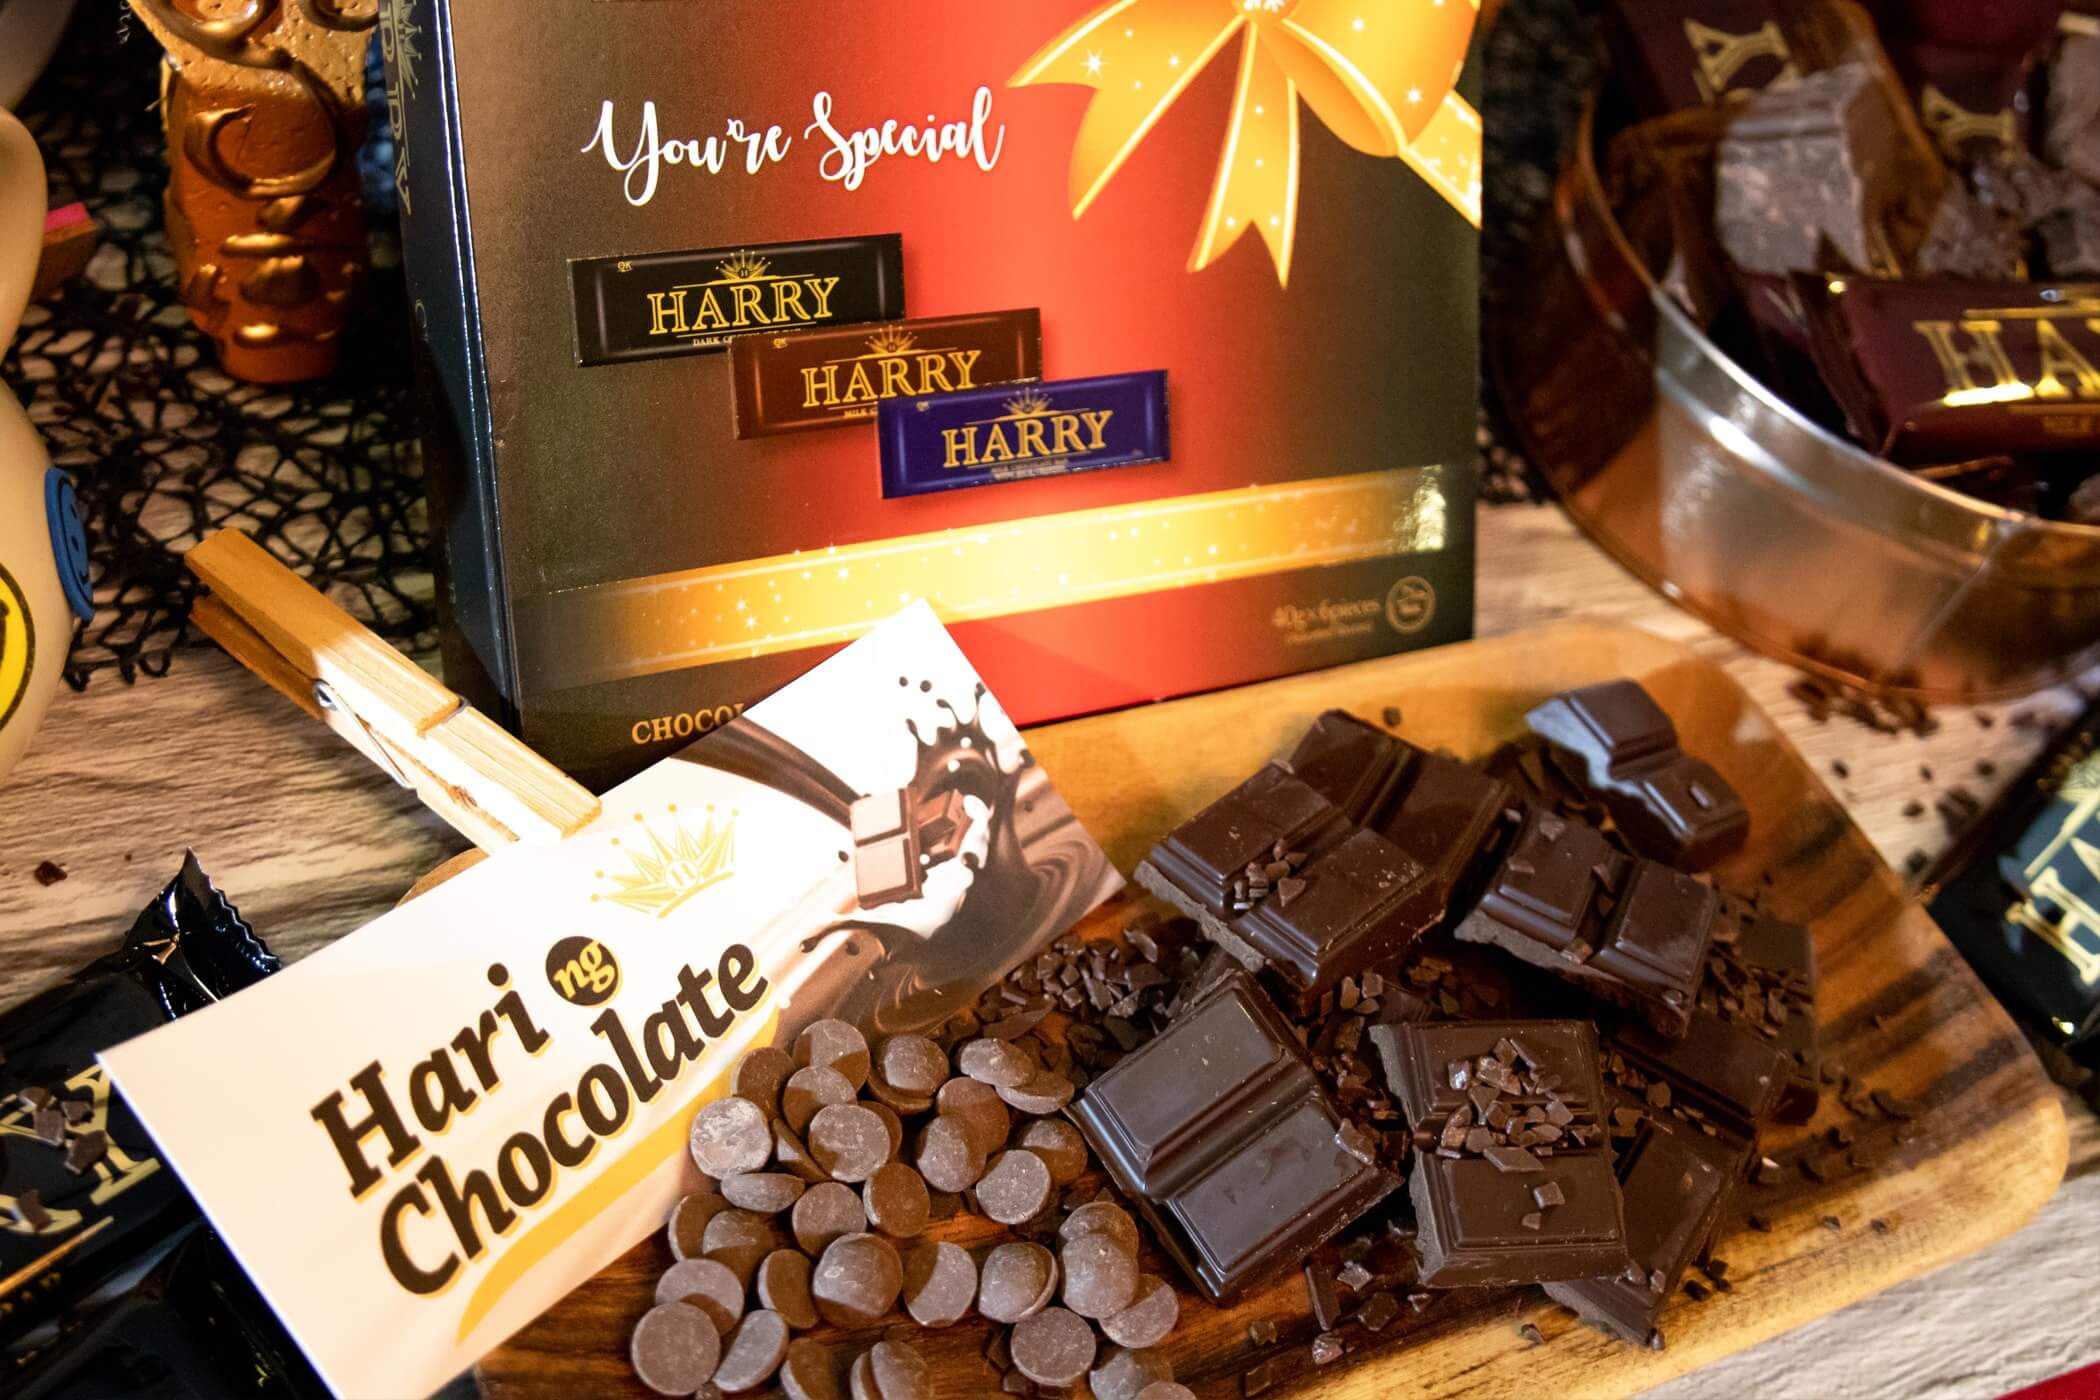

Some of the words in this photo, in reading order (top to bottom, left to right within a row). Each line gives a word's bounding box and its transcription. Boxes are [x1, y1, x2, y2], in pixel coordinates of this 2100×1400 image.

[581, 99, 792, 207] You're
[804, 86, 1005, 191] Special
[647, 275, 840, 335] HARRY
[800, 349, 982, 408] HARRY
[1911, 318, 2100, 407] HA
[941, 409, 1114, 469] HARRY
[310, 962, 551, 1201] Hari
[552, 938, 617, 1000] ng
[380, 943, 770, 1296] Chocolate
